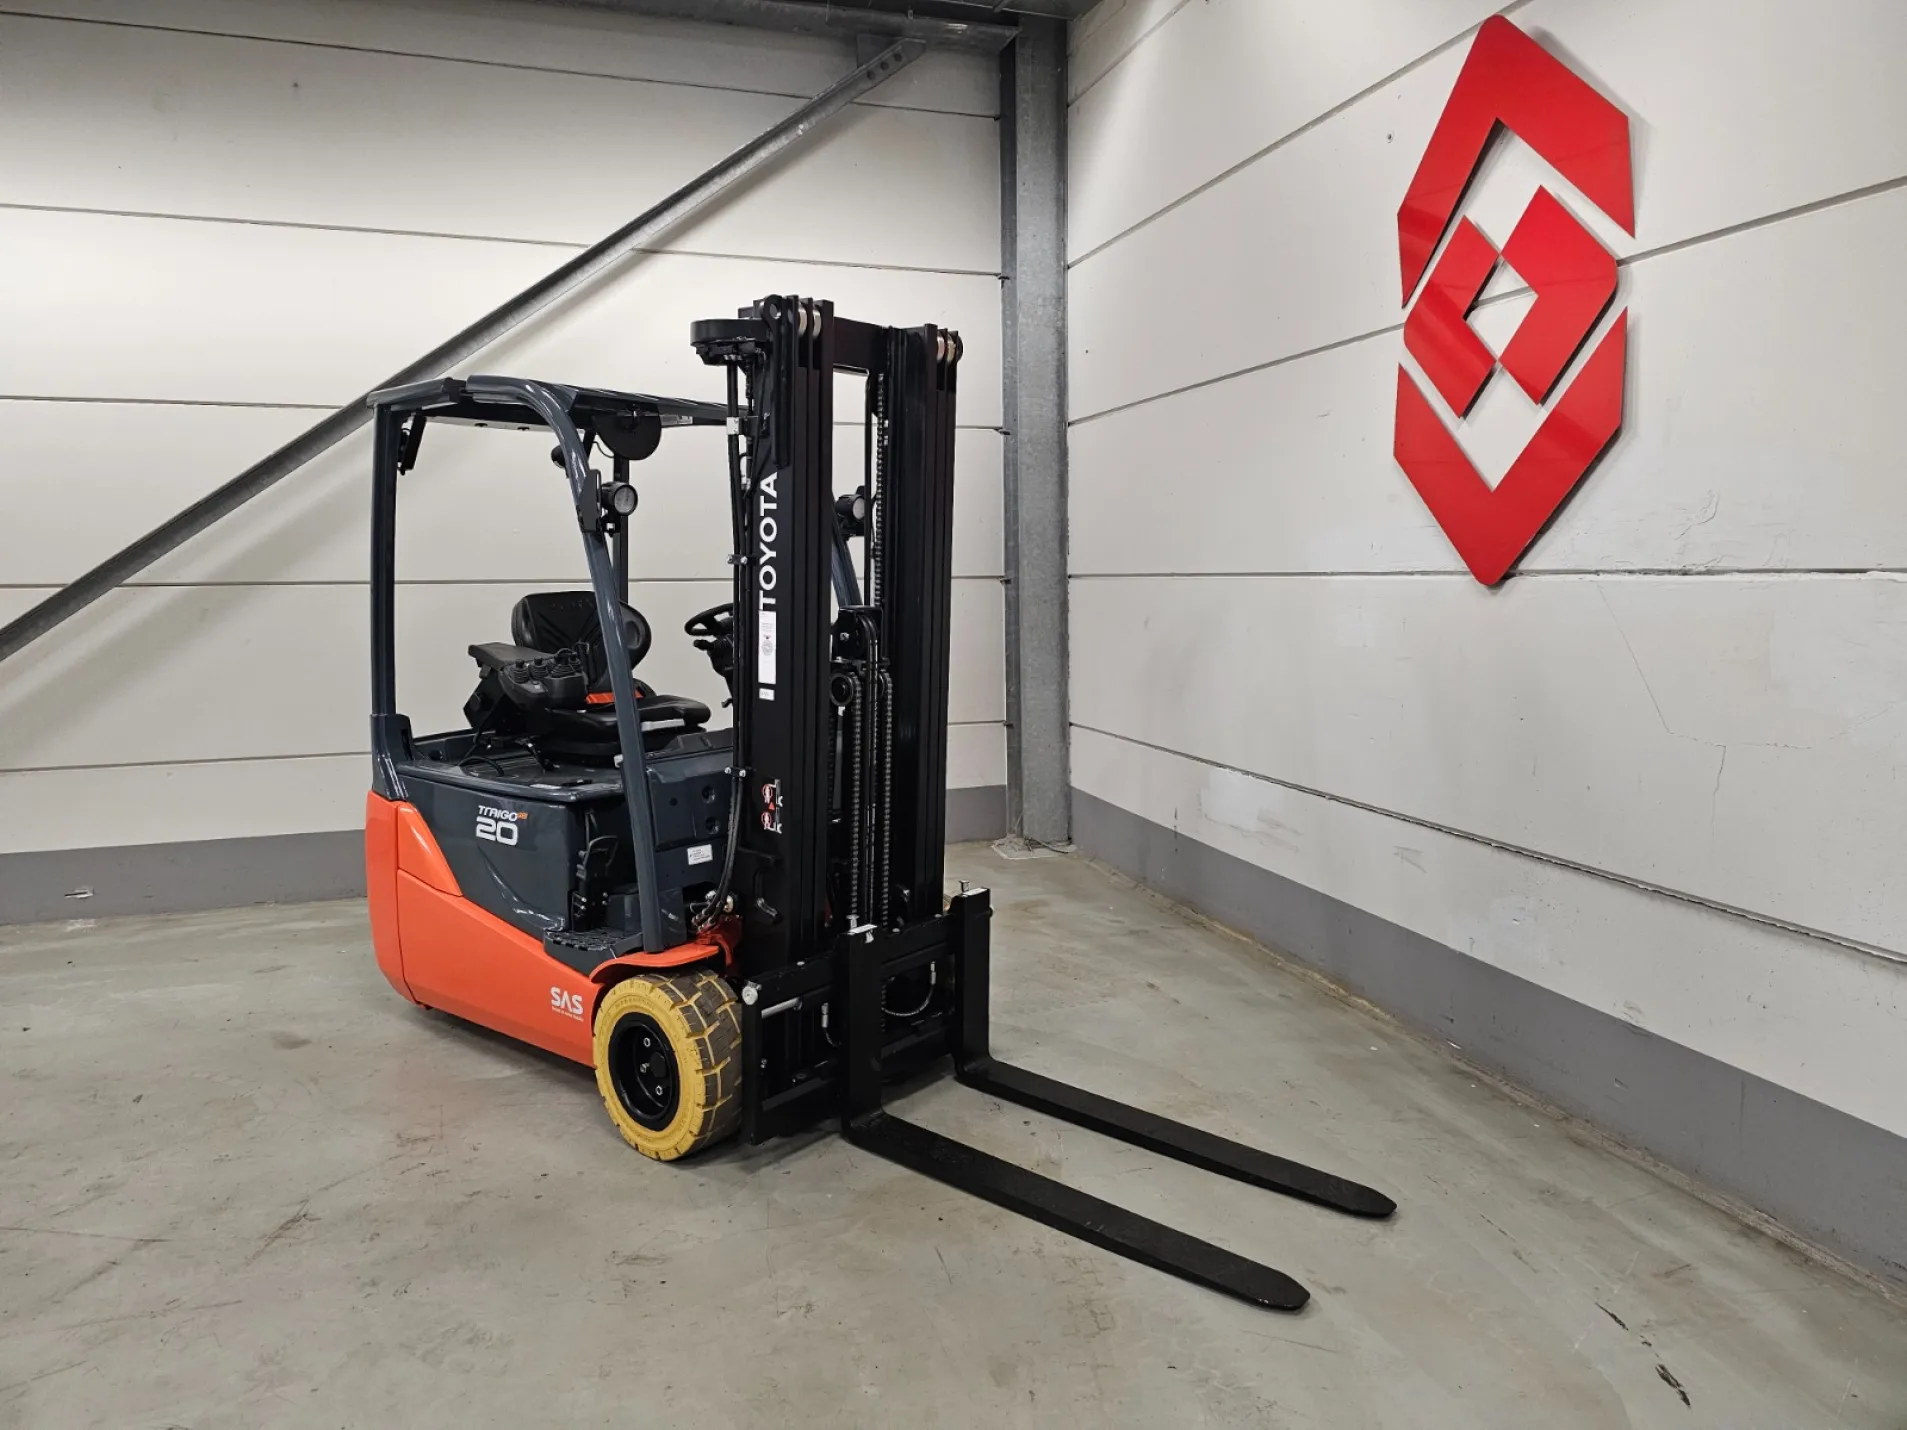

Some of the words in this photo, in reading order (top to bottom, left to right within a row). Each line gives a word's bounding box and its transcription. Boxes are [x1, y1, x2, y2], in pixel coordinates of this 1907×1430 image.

[759, 471, 778, 610] TOYOTA
[475, 816, 518, 846] 20
[550, 986, 584, 1015] SAS
